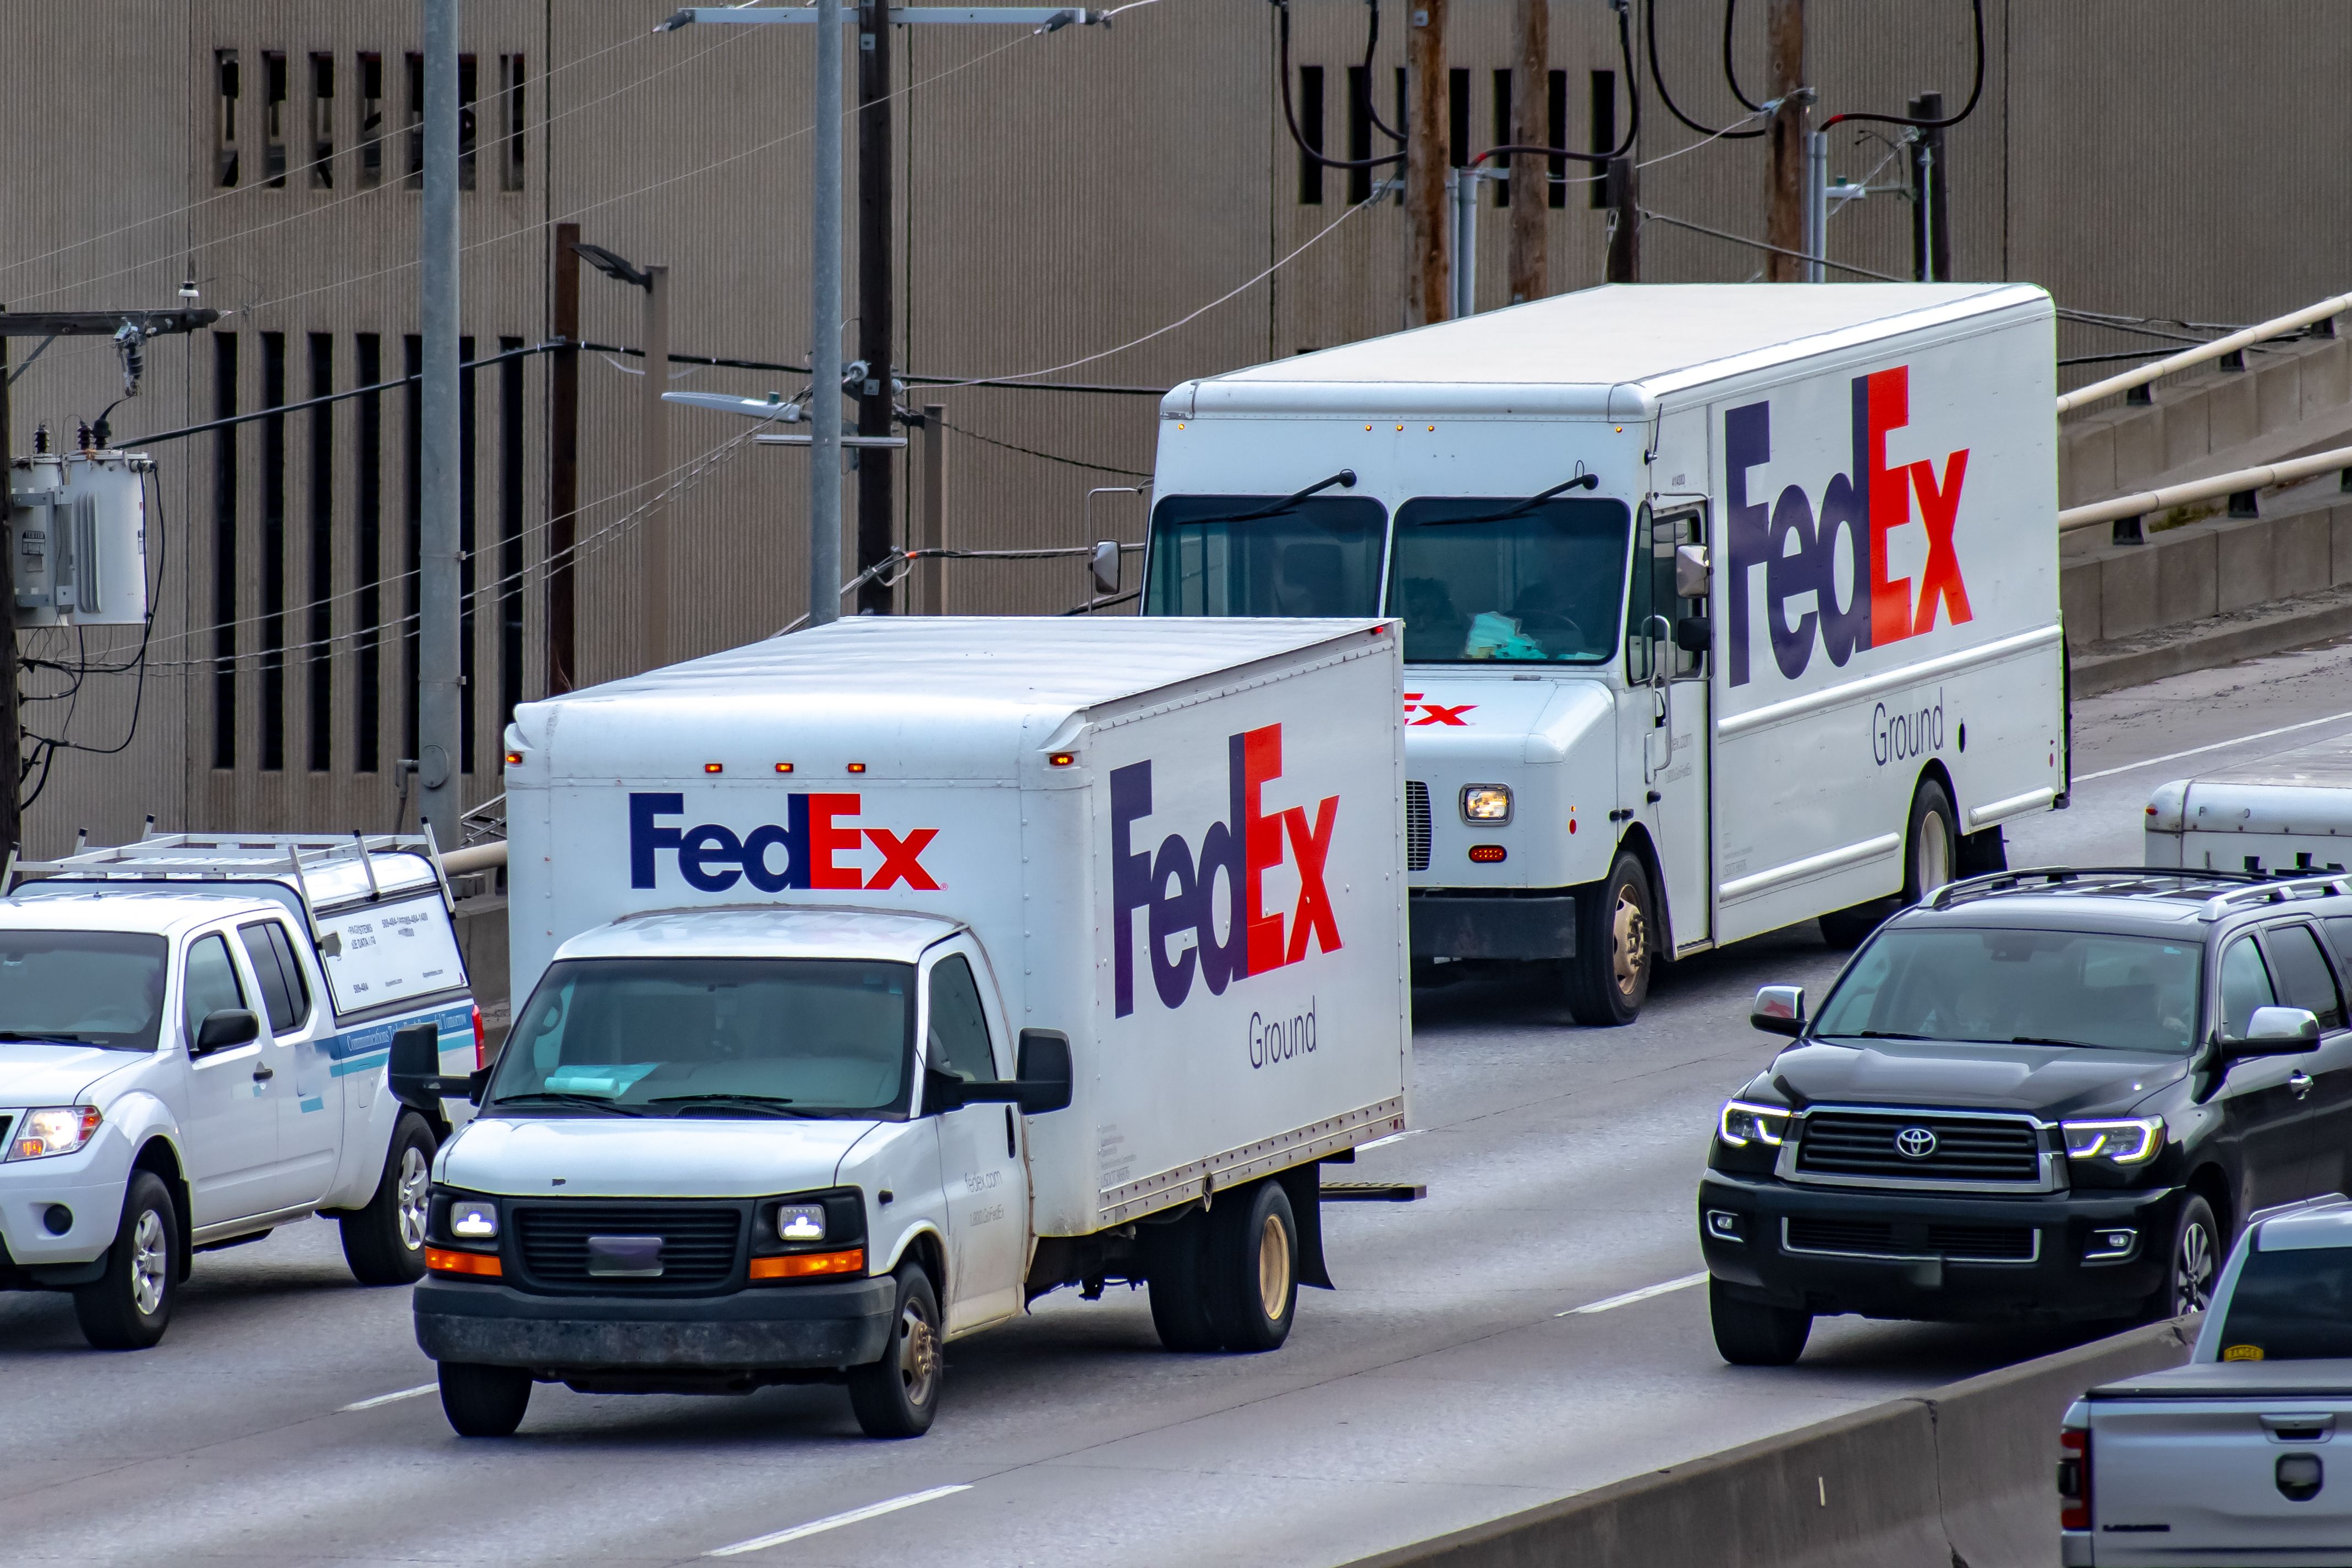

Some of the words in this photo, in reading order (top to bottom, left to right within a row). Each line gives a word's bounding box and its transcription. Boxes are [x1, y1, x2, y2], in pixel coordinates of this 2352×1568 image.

[1725, 365, 1973, 688] FedEx
[1873, 687, 1943, 767] Ground
[629, 792, 941, 893] FedEx
[1110, 722, 1343, 1019] FedEx
[347, 1028, 389, 1051] Communications
[1249, 995, 1317, 1069] Ground
